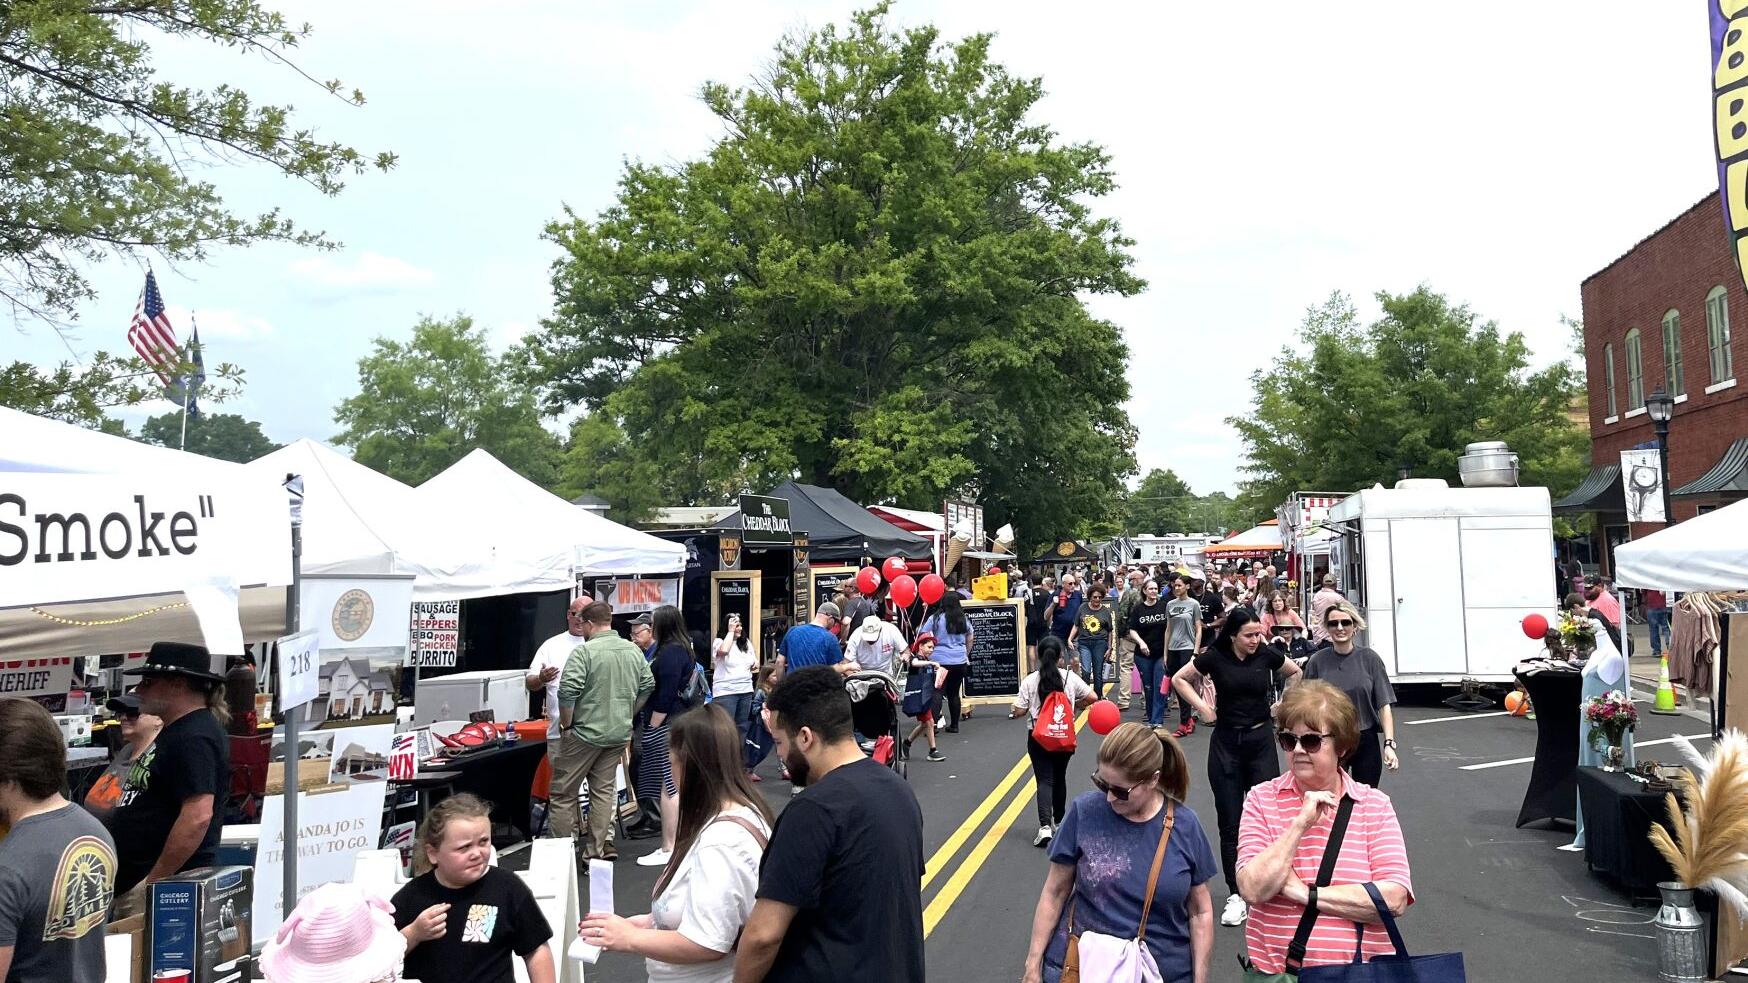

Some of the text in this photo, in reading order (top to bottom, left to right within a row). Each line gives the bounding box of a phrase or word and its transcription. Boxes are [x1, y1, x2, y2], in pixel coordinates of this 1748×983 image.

[762, 503, 772, 515] THE
[0, 493, 214, 566] Smoke"
[743, 514, 792, 535] CHEDDAR BLOCK
[414, 604, 458, 614] SAUSAGE
[413, 620, 457, 629] PEPPERS
[413, 631, 457, 642] BBQ PORK
[420, 641, 457, 650] CHICKEN
[290, 651, 311, 677] 218
[411, 650, 455, 666] BURRITO
[275, 818, 365, 843] AANDA JO IS
[327, 840, 345, 853] TO
[347, 836, 369, 850] GO.
